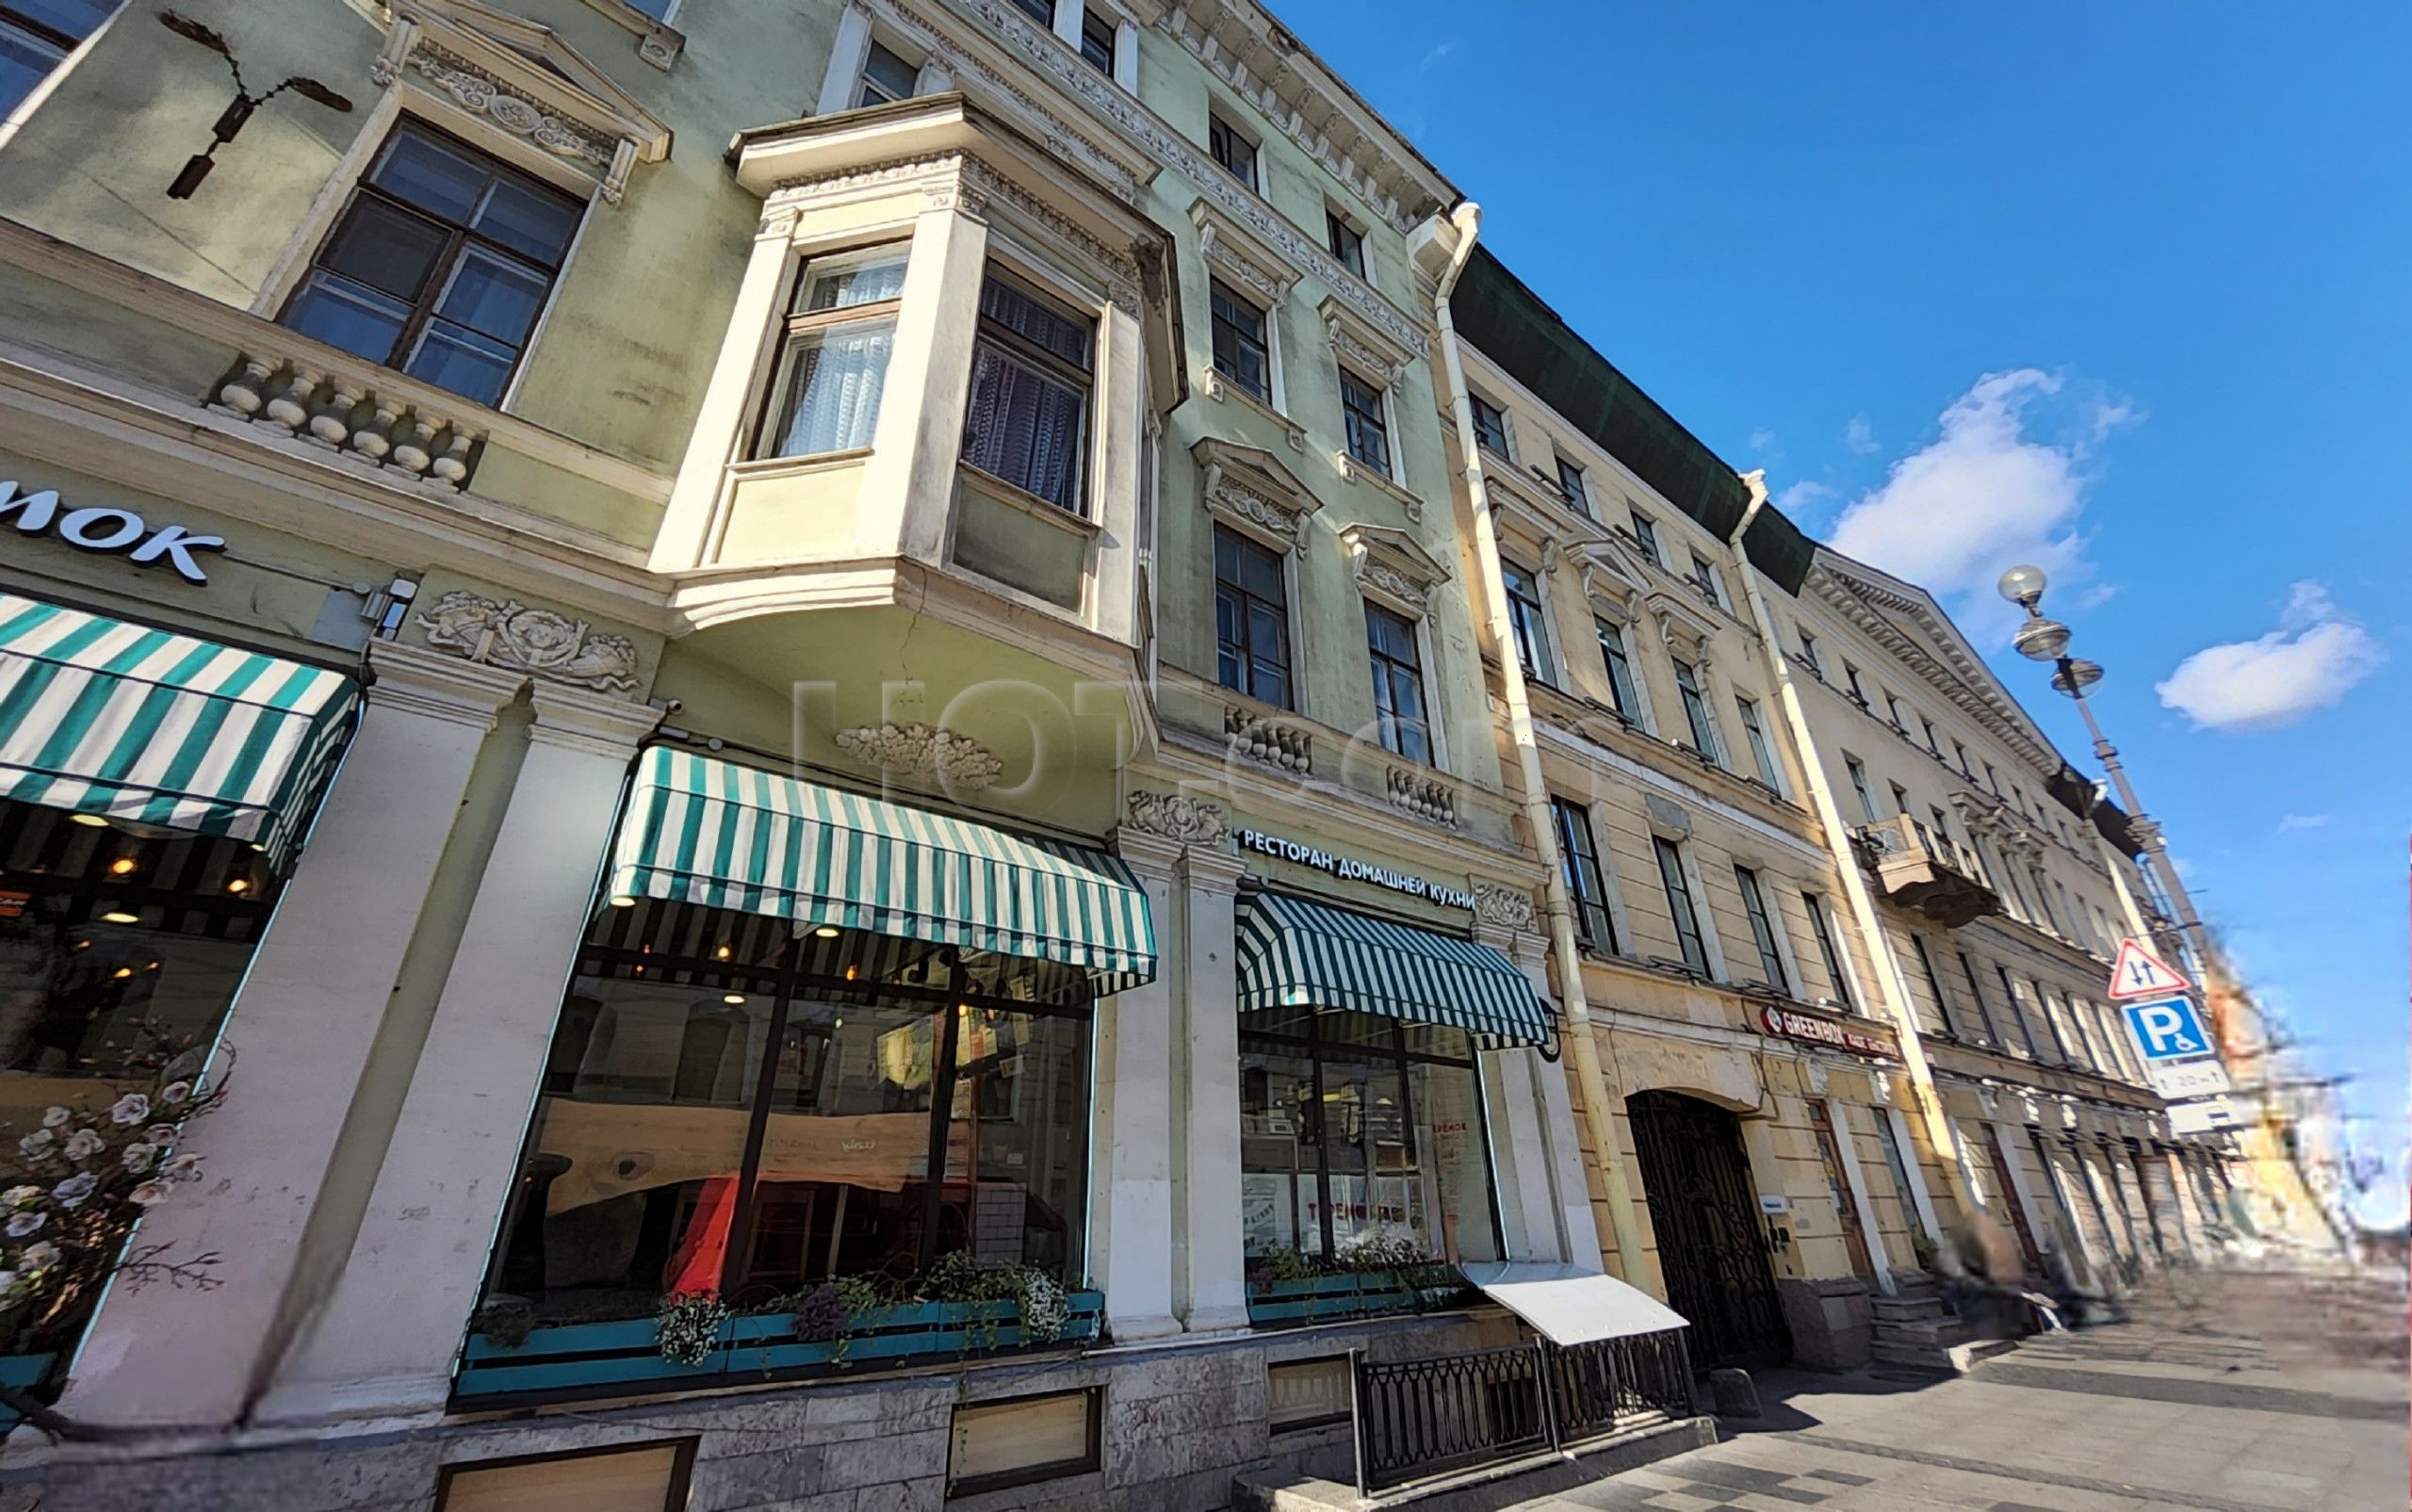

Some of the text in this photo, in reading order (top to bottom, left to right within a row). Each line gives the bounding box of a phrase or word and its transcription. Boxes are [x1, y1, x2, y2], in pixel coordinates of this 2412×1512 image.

[1244, 829, 1476, 910] РЕСТОРАН ДОМАШНЕЙ КУХНИ
[2137, 1005, 2183, 1052] P
